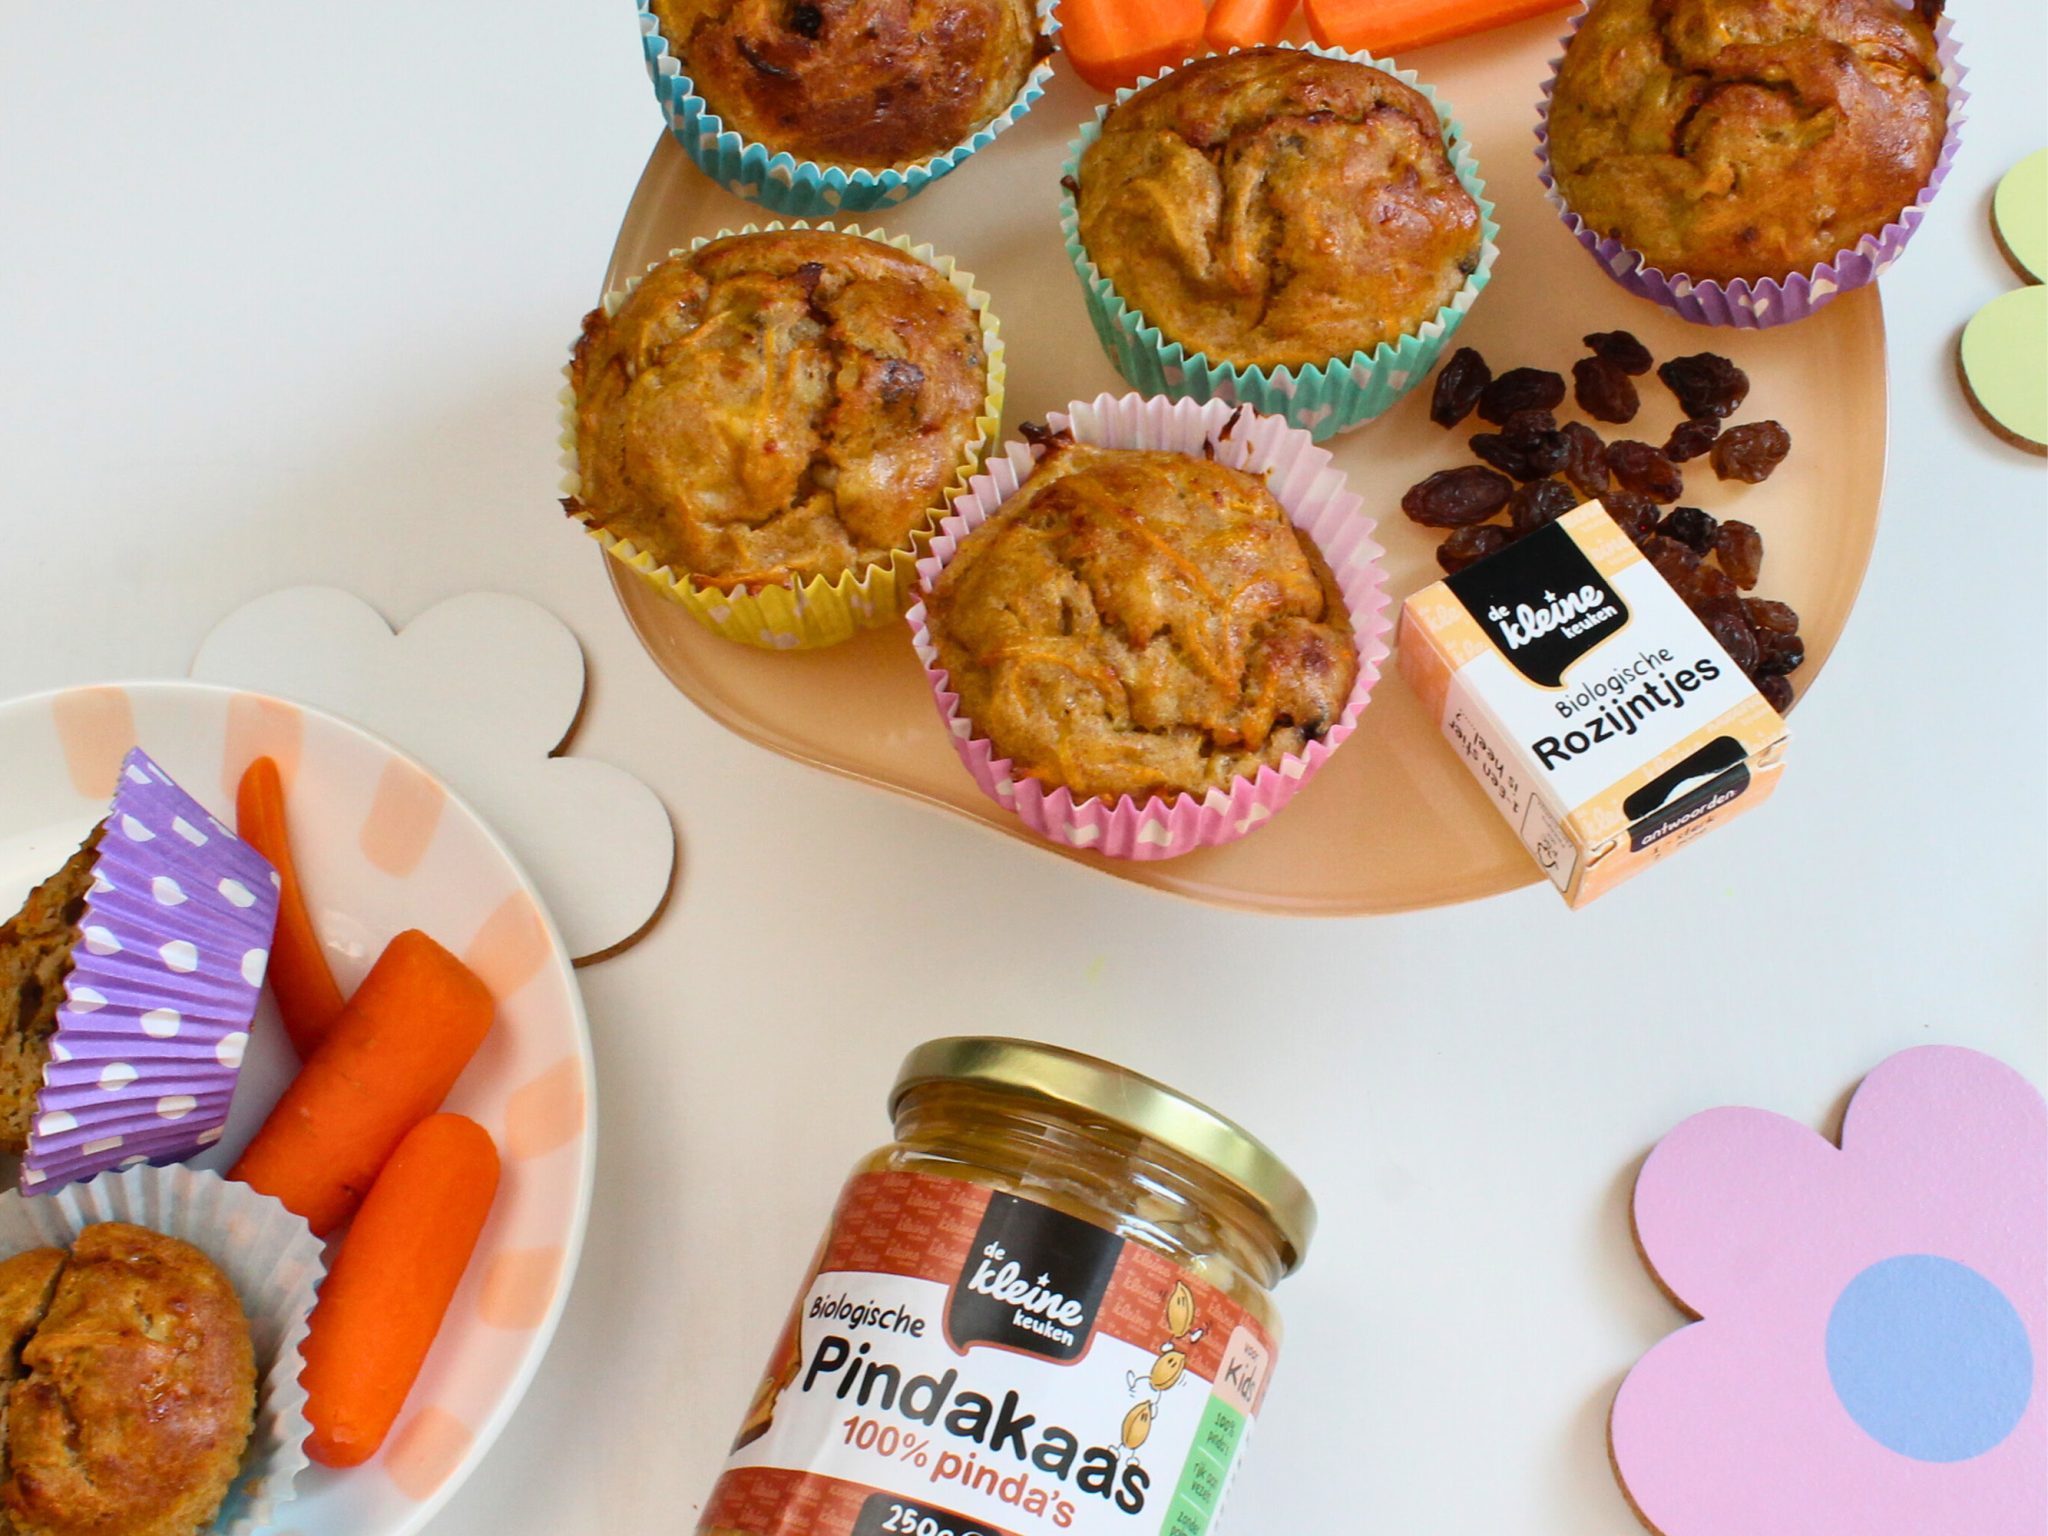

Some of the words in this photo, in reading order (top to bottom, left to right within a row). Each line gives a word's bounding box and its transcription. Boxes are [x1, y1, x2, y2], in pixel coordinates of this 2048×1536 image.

[1488, 605, 1511, 622] de
[1499, 585, 1605, 650] kleine
[1560, 605, 1618, 639] keuken
[1555, 646, 1674, 719] Biologische
[1448, 719, 1479, 761] stier
[1532, 658, 1721, 771] Rozijntjes
[1641, 789, 1736, 846] antwoorden
[983, 1241, 1006, 1260] de
[808, 1297, 926, 1338] Biologische
[968, 1259, 1083, 1327] kleine
[1012, 1309, 1075, 1347] keuken
[1224, 1357, 1257, 1402] Kids
[802, 1335, 1151, 1515] Pindakaas
[842, 1415, 931, 1469] 100%
[931, 1446, 1075, 1529] pinda's
